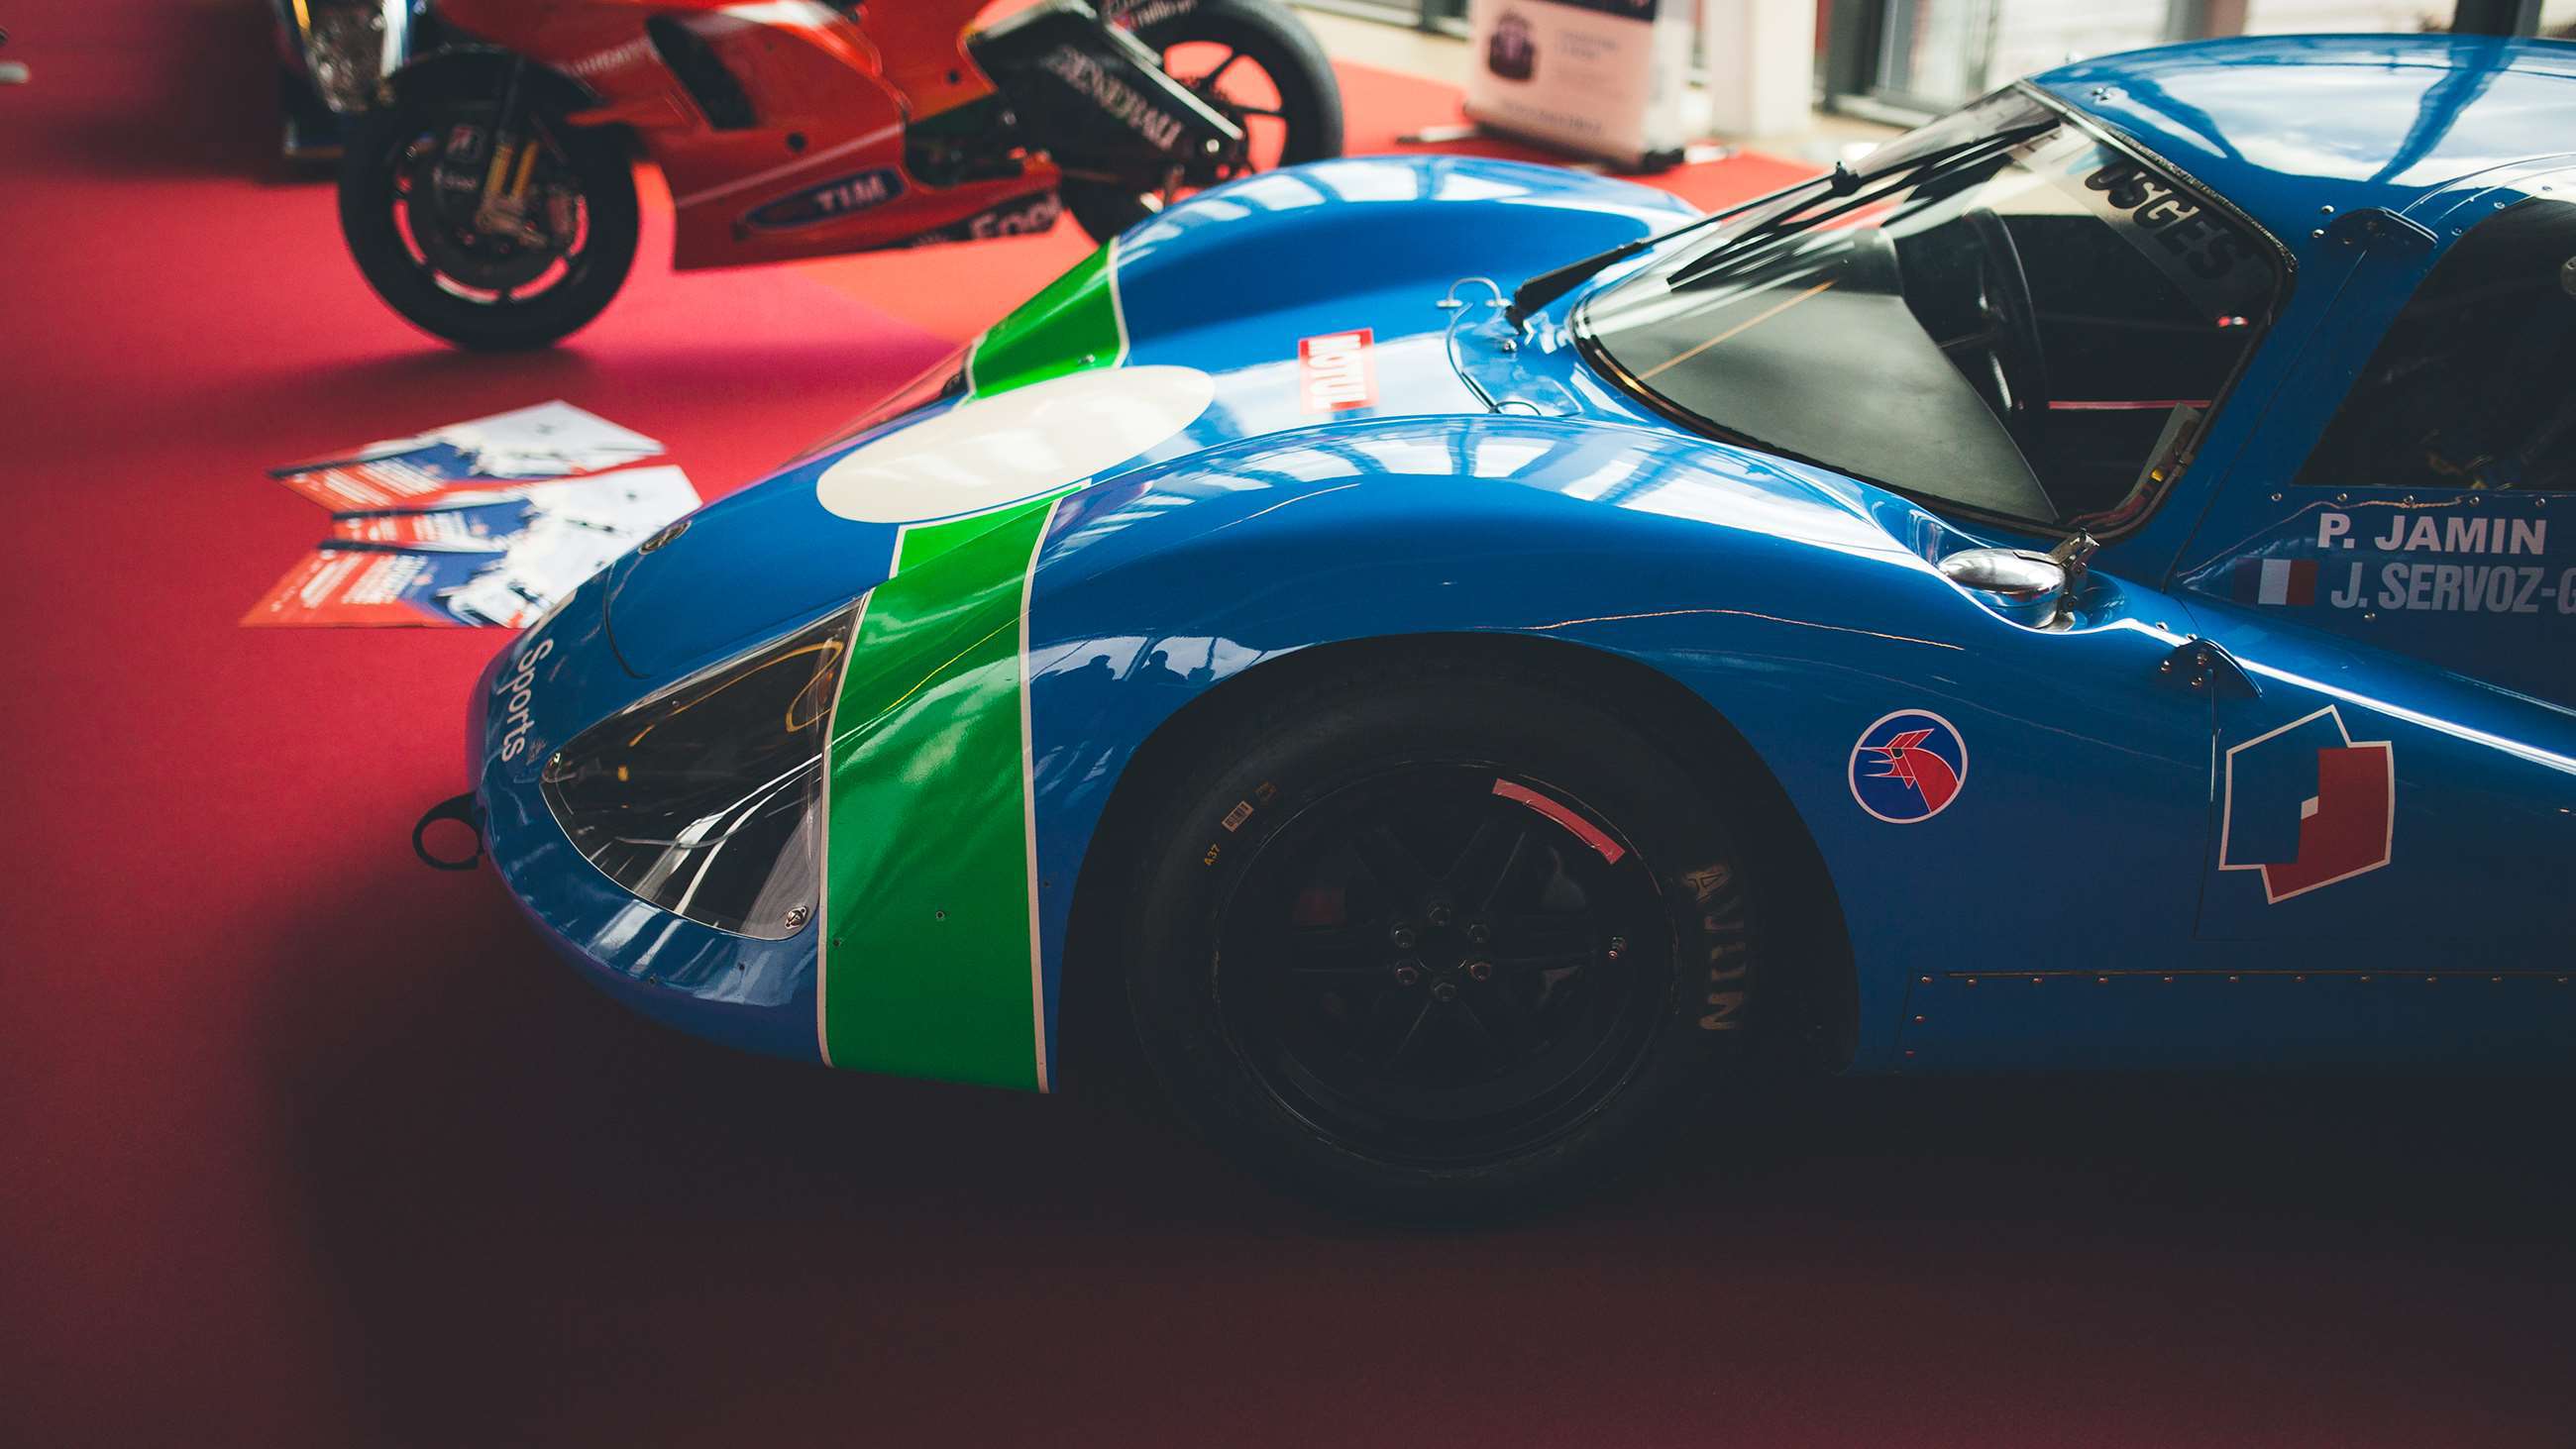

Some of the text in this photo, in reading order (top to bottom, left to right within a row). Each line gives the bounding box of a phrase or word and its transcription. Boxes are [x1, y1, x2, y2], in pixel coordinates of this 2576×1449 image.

[815, 174, 888, 211] TIM
[1307, 334, 1367, 409] MOTUL
[2317, 513, 2547, 555] P. JAMIN
[2330, 562, 2368, 609] J.
[496, 638, 554, 762] Sports
[1204, 843, 1222, 867] A37
